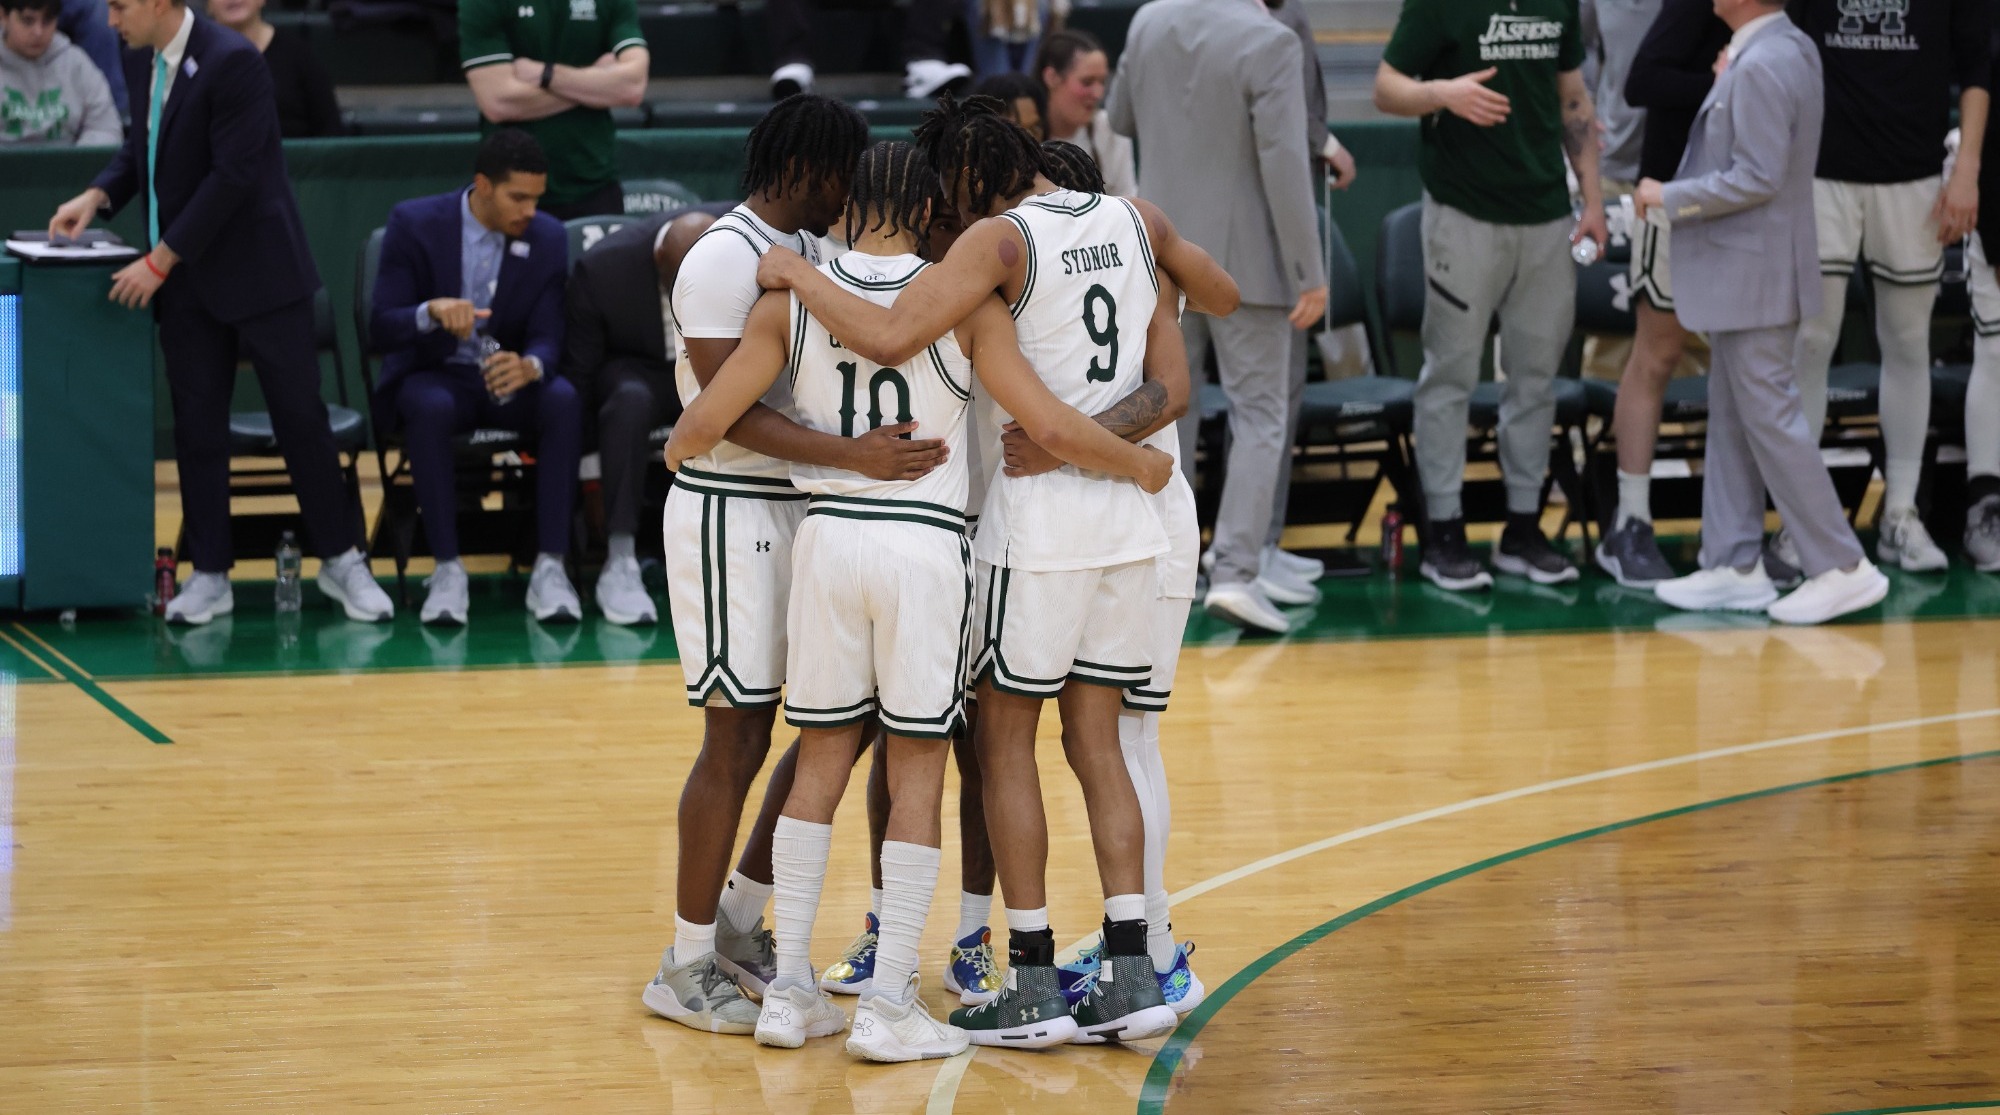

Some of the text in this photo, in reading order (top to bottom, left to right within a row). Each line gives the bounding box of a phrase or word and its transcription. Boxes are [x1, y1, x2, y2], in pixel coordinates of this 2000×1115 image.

[1478, 13, 1563, 45] JASPERS
[1824, 33, 1919, 51] BASKETBALL
[1061, 242, 1123, 275] SYDNOR
[1082, 283, 1119, 384] 9
[836, 361, 914, 440] 10
